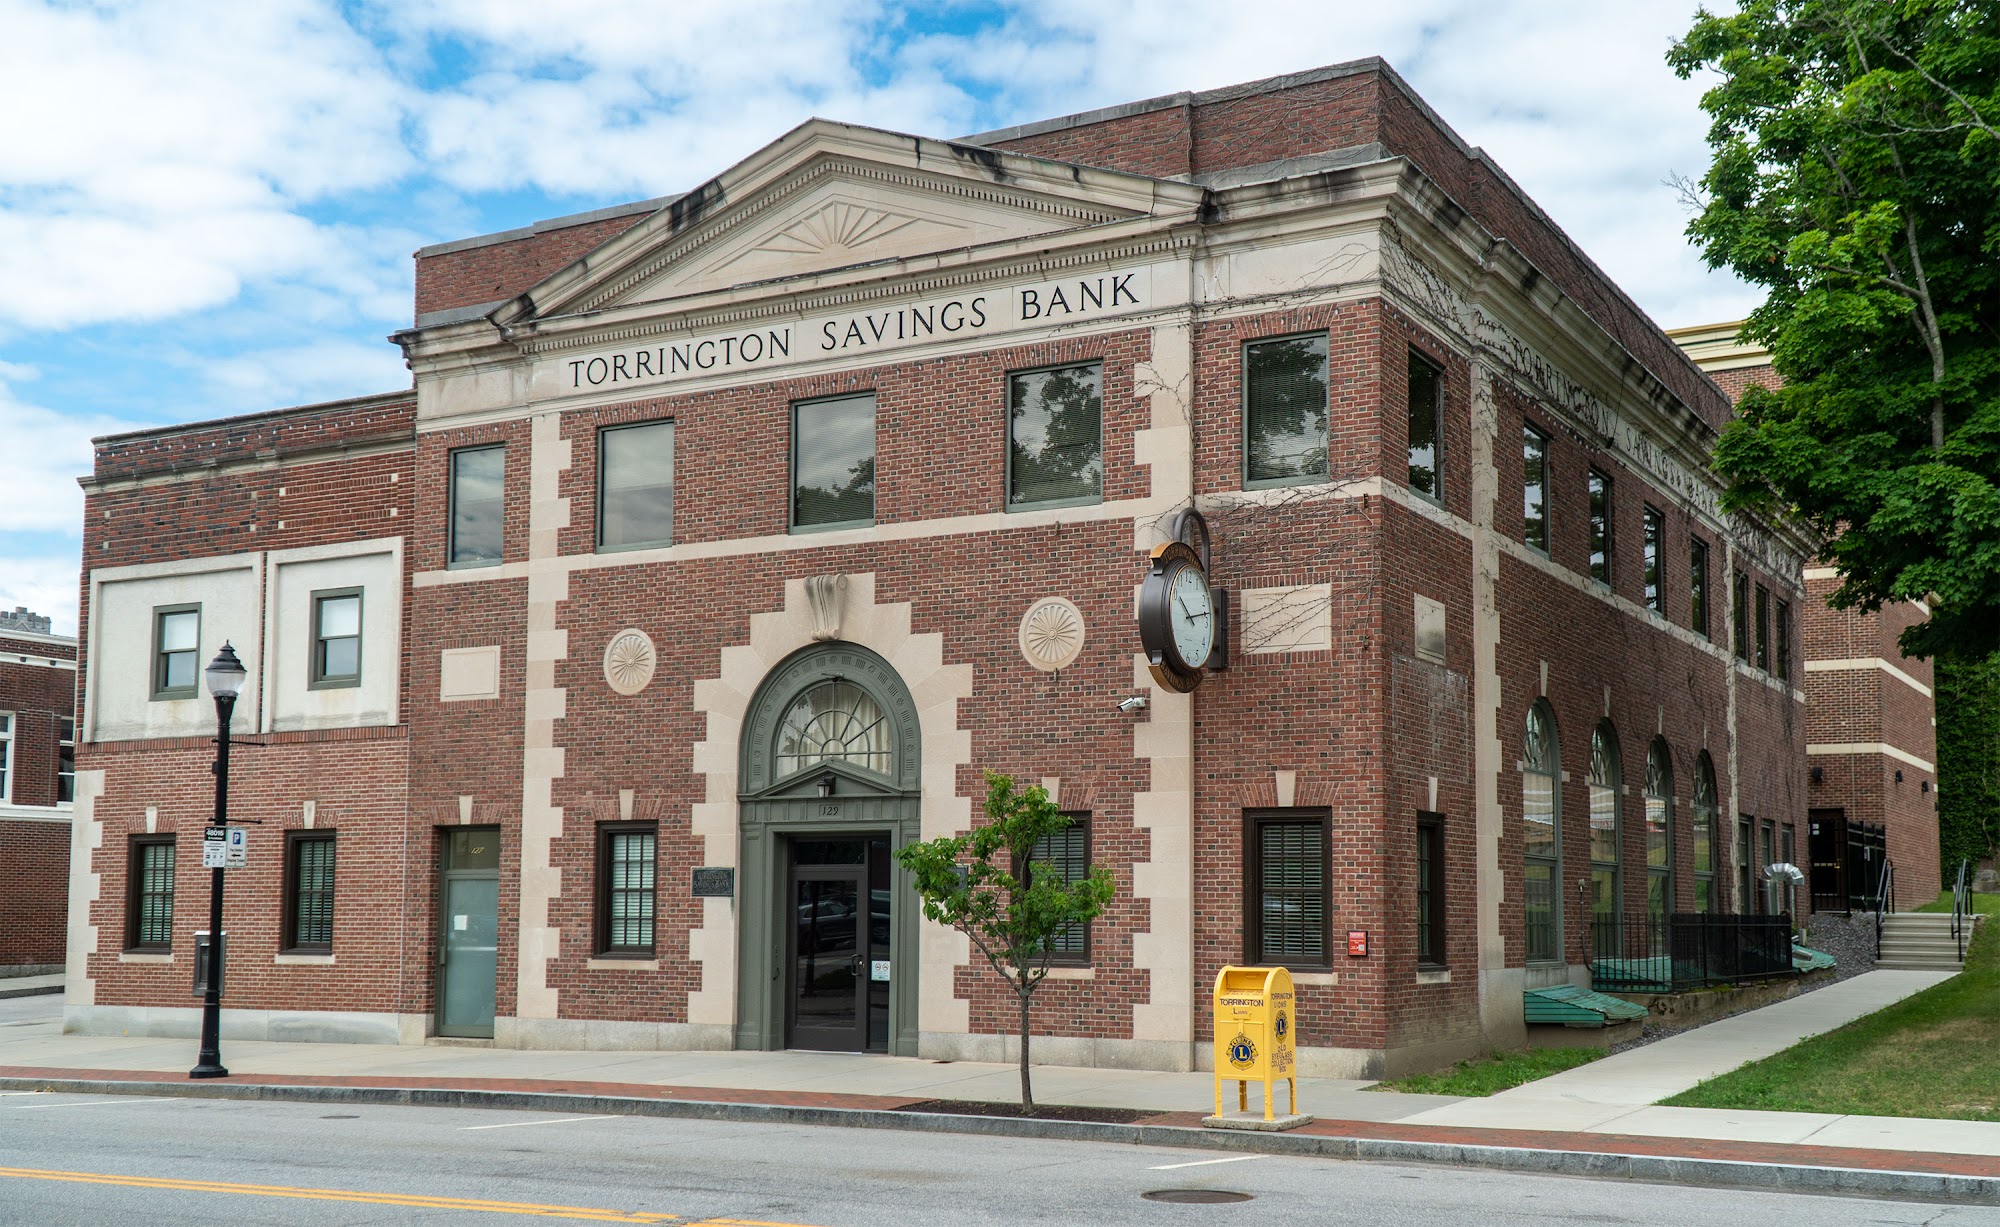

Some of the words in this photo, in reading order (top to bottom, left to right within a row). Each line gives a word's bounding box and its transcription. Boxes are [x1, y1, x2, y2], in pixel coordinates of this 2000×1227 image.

[568, 328, 790, 388] TORRINGTON
[821, 297, 987, 351] SAVINGS
[1020, 273, 1140, 321] BANK
[1513, 337, 1609, 436] TORRINGTON
[1185, 569, 1192, 584] 12
[1201, 594, 1206, 607] 2
[1194, 649, 1199, 662] 5
[822, 806, 839, 816] 129
[234, 833, 240, 844] P
[471, 846, 484, 854] 127
[1220, 998, 1264, 1007] TORRINGTON
[1271, 992, 1293, 1001] TORRINGTON
[1274, 1001, 1287, 1009] LIONS
[1238, 1046, 1248, 1059] L
